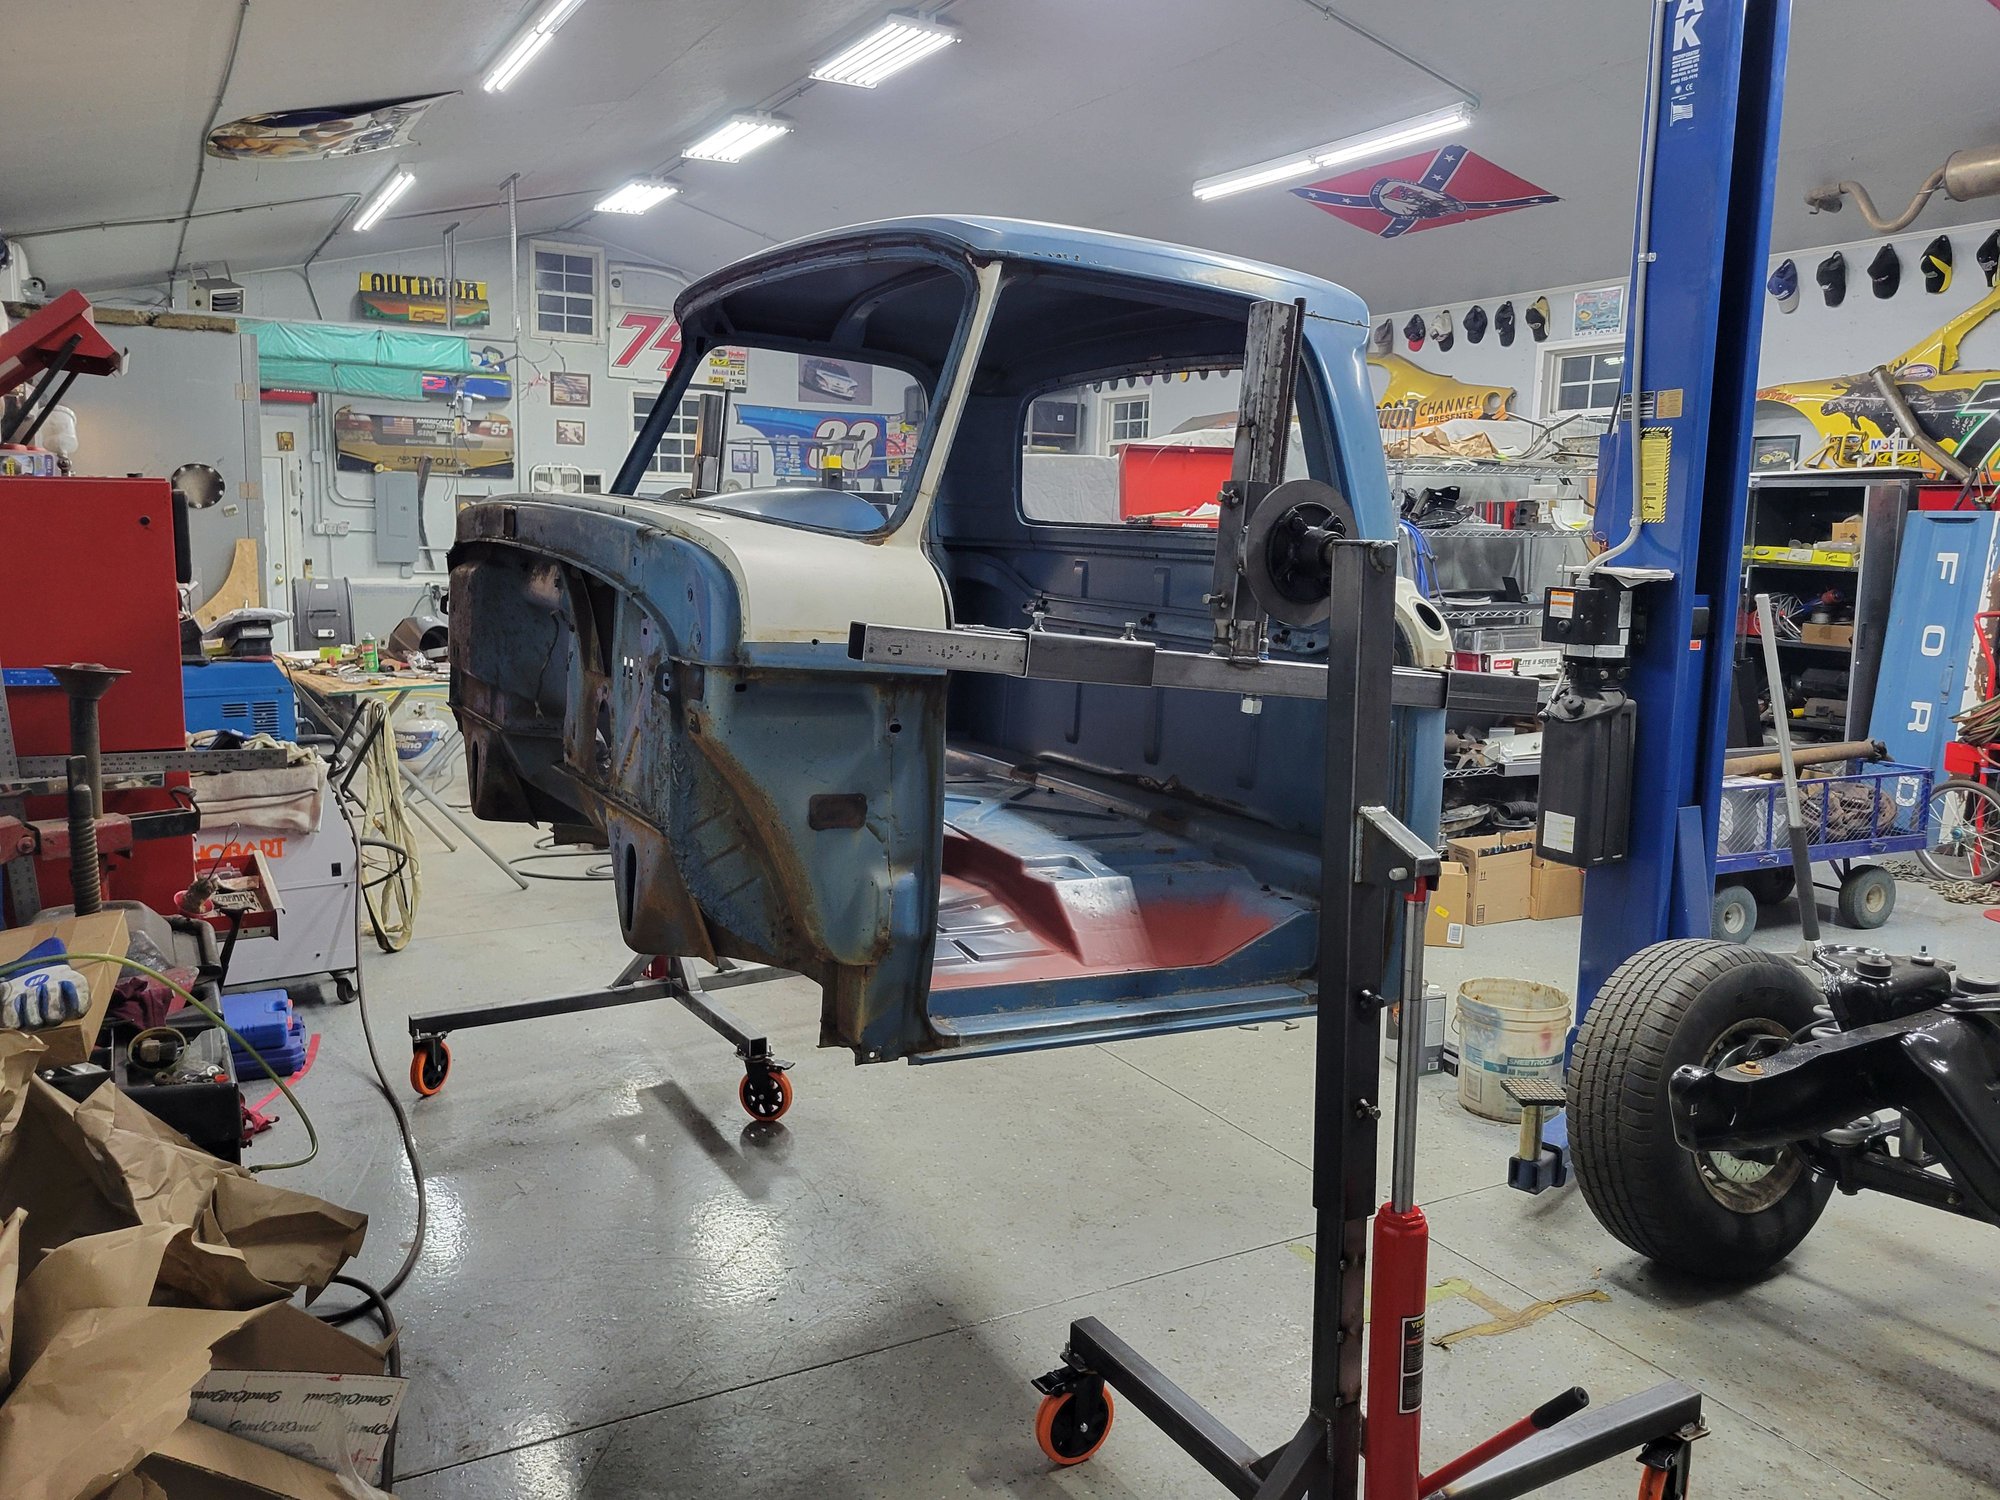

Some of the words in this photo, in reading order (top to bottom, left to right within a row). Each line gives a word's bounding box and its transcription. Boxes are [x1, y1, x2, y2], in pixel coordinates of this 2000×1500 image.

[1428, 411, 1474, 424] PRESENTS
[491, 422, 508, 436] 55
[411, 456, 458, 467] TOTA
[1508, 1058, 1553, 1067] SHEETROCK
